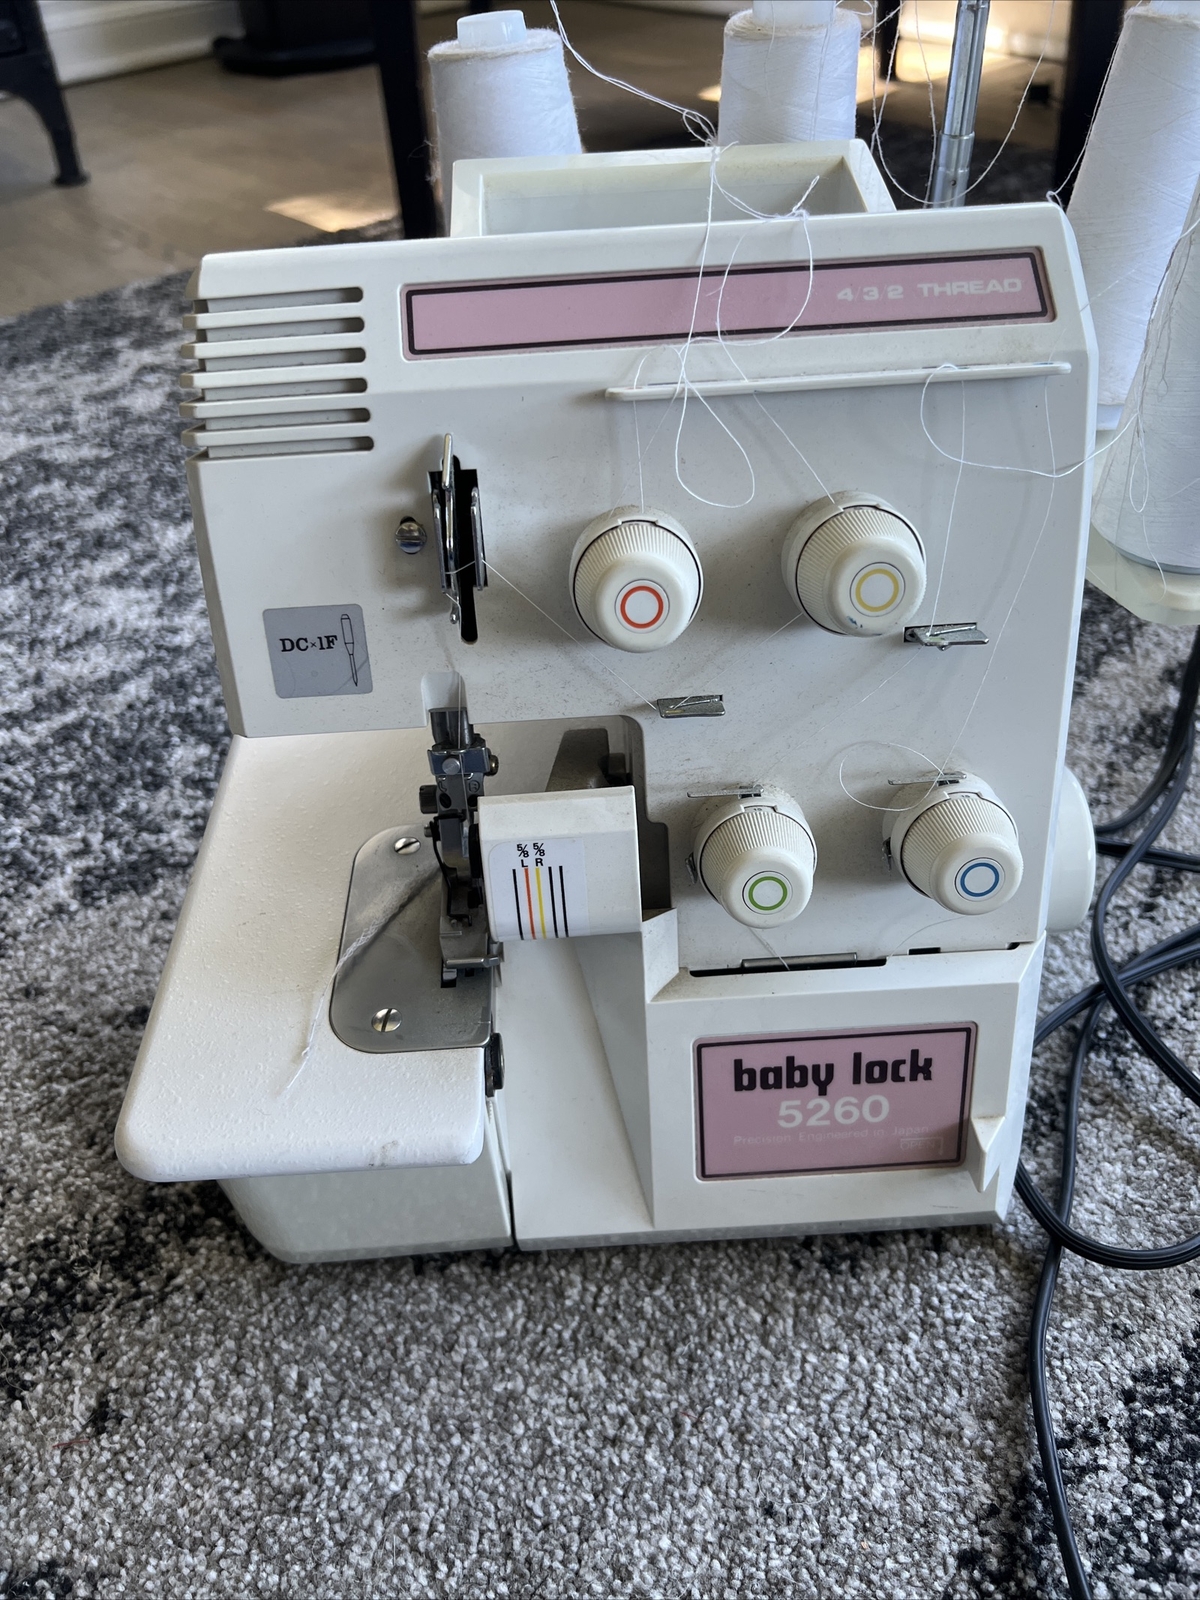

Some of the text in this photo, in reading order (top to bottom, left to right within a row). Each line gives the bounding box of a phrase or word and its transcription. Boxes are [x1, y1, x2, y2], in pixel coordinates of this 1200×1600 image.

[917, 278, 1023, 297] THREAD
[521, 858, 543, 867] L R
[733, 1048, 934, 1097] baby lock
[777, 1094, 891, 1128] 5260
[733, 1123, 930, 1147] Precision Engineered in Japan
[900, 1140, 936, 1151] OPEN
